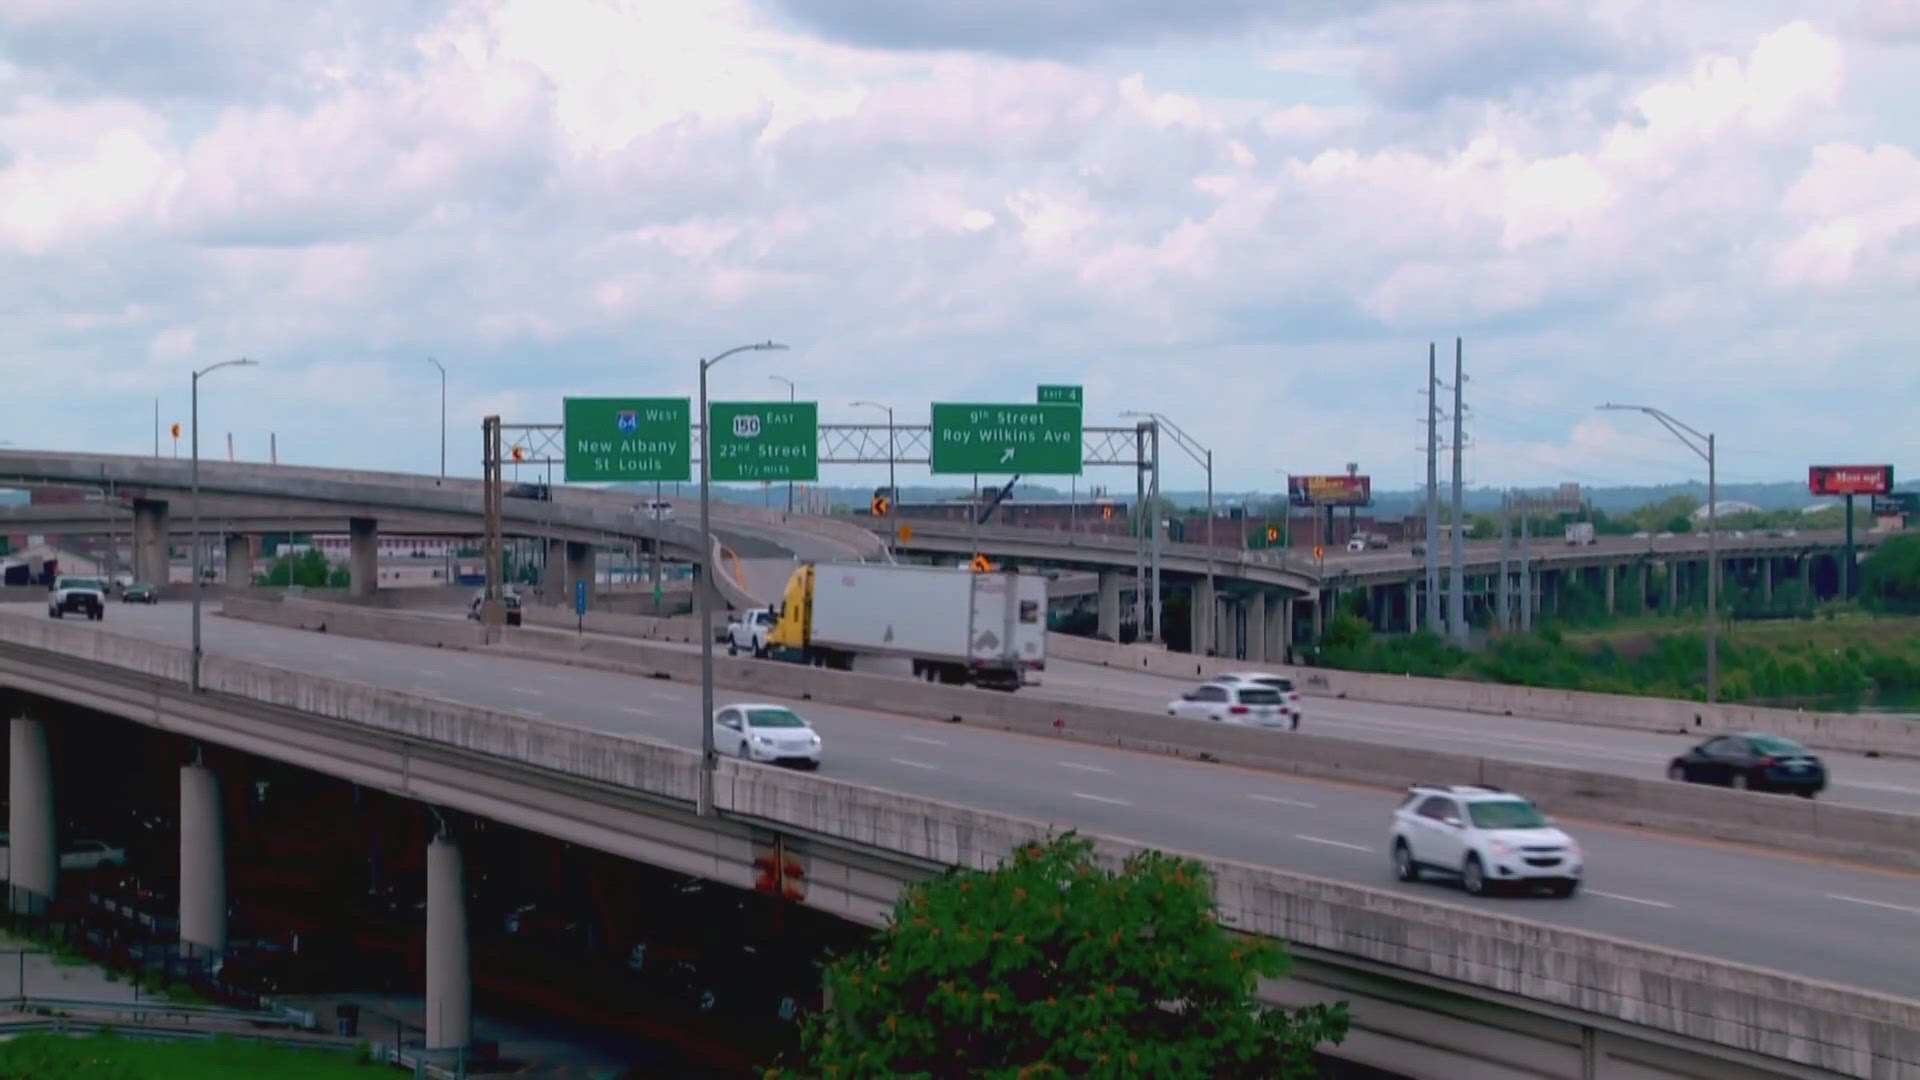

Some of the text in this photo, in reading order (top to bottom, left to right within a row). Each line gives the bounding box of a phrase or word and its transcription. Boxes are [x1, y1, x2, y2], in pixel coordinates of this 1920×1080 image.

[1069, 389, 1076, 400] 4
[619, 415, 637, 429] 64
[735, 411, 794, 433] 150 EAST
[970, 411, 1045, 424] 9th Street
[943, 428, 1071, 444] Roy Wilkins Ave
[578, 439, 677, 455] New Albany
[720, 443, 807, 457] 22nd Street
[594, 458, 662, 471] St Louis
